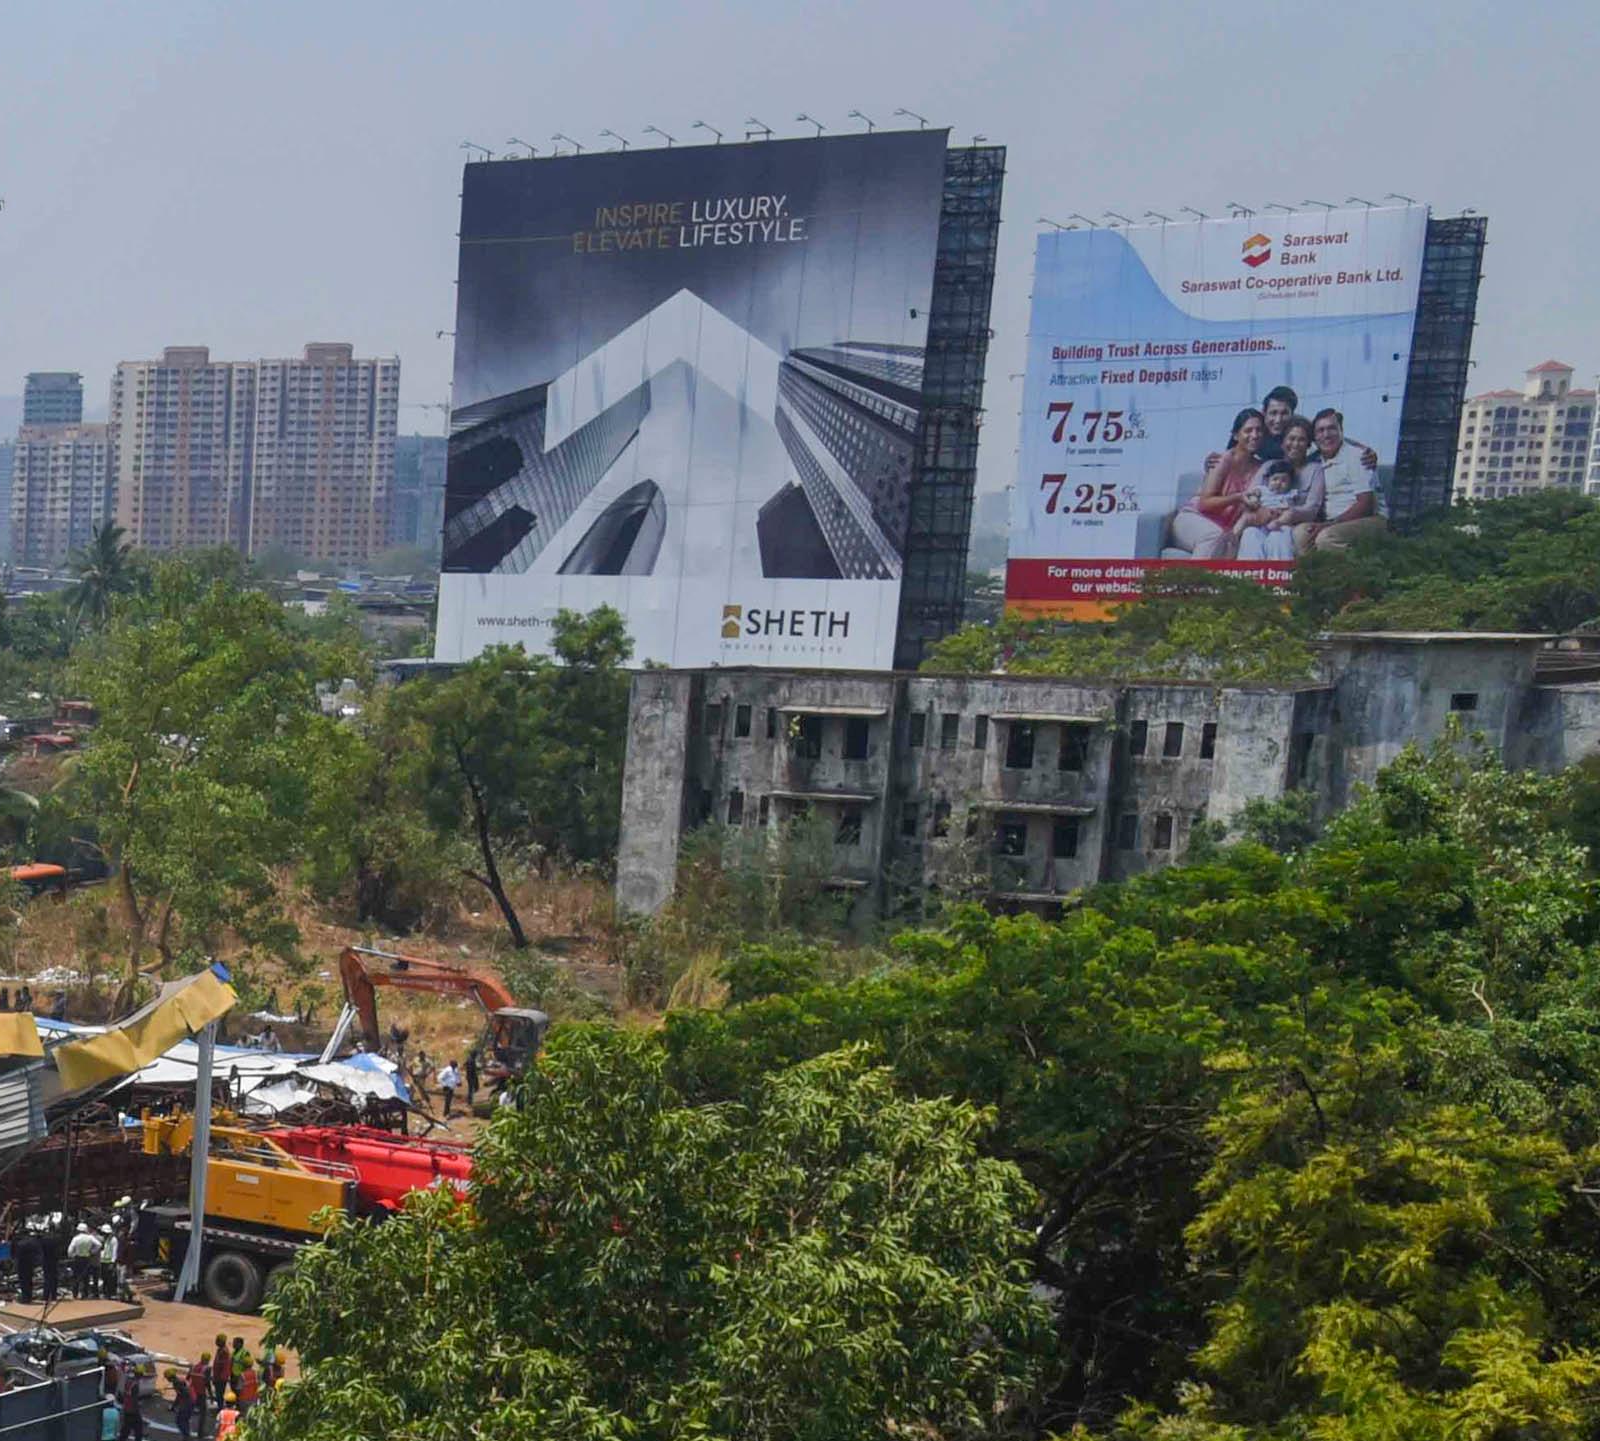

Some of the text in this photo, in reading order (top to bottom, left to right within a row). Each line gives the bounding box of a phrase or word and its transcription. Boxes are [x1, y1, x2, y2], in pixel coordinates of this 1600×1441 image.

[595, 195, 789, 228] INSPIRE LUXURY.
[573, 218, 809, 253] ELEVATE LIFESTYLE.
[1283, 232, 1348, 247] Saraswat
[1280, 251, 1316, 265] Bank
[1181, 268, 1404, 293] Saraswat Co-operative Bank Ltd.
[1052, 338, 1286, 360] Building Trust Across Generations...
[1049, 367, 1223, 386] Attractive Fixed Deposit rates!
[1046, 402, 1124, 443] 7.75
[1040, 473, 1117, 514] 7.25
[1048, 566, 1145, 578] For more details
[1072, 583, 1093, 593] our
[745, 609, 850, 638] SHETH
